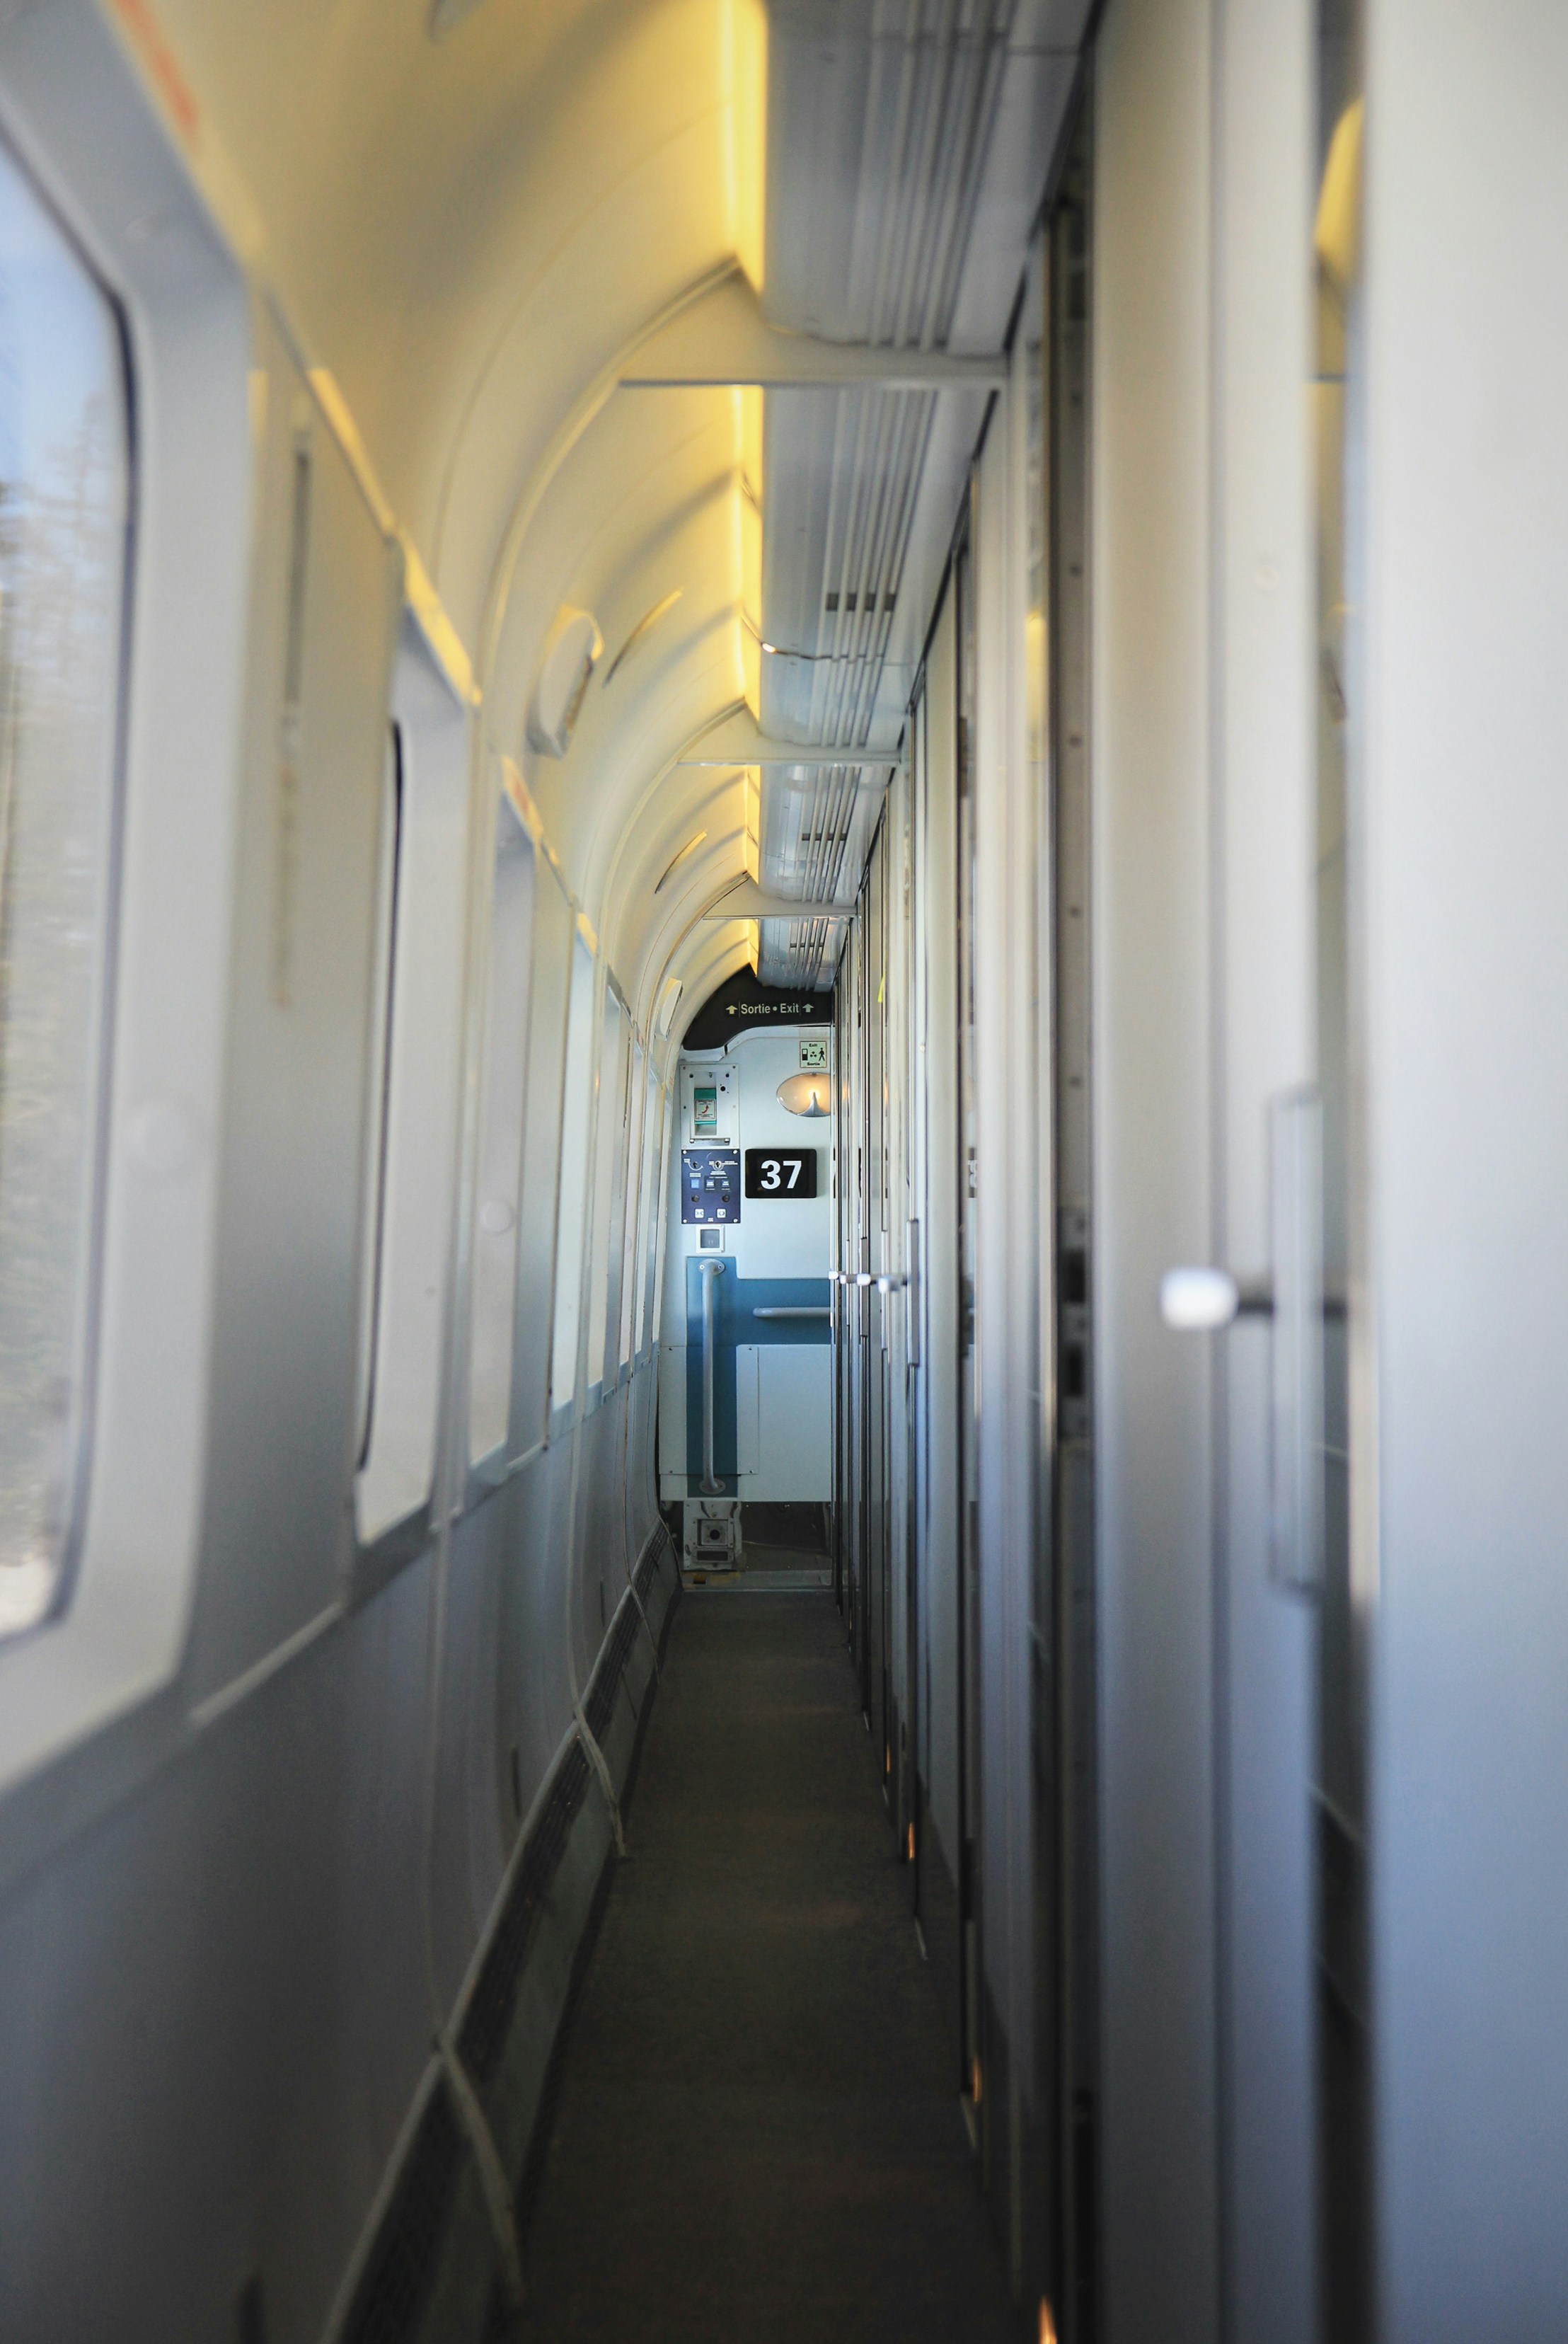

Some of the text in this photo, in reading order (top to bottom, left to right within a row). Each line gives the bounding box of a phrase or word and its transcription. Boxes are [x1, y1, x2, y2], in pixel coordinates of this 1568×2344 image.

[741, 1003, 800, 1014] Sortie Exit
[761, 1160, 802, 1190] 37
